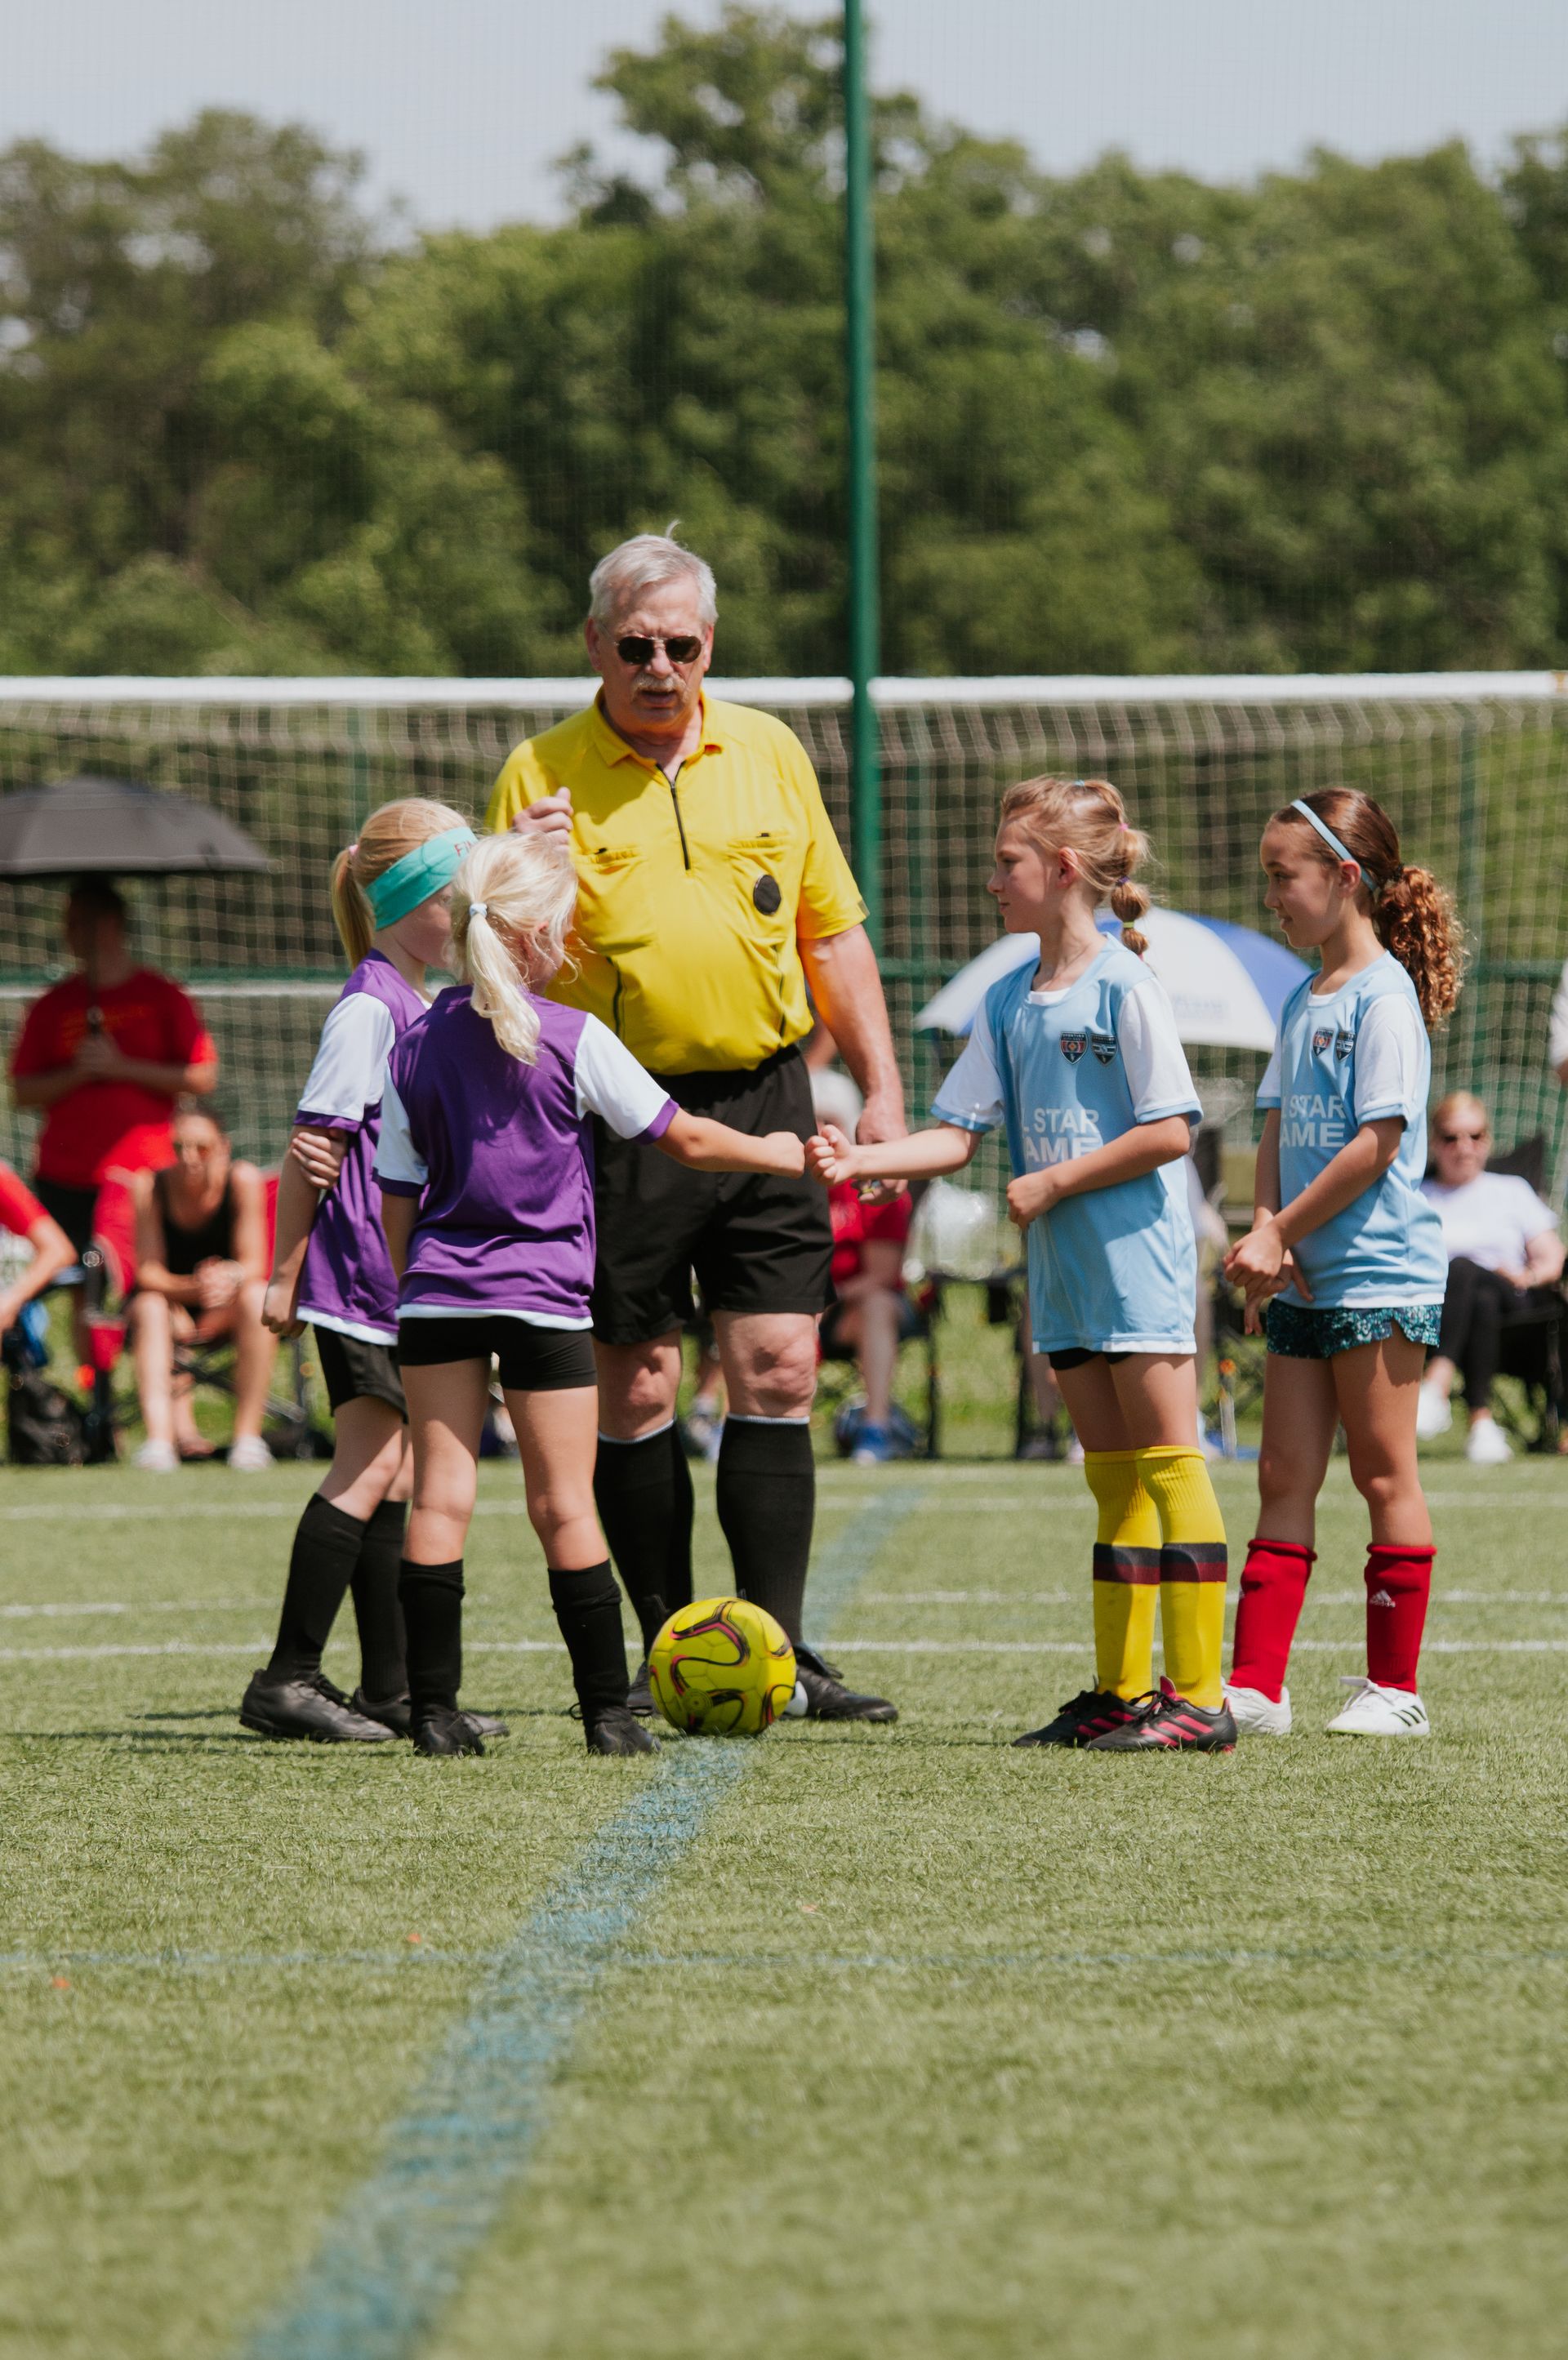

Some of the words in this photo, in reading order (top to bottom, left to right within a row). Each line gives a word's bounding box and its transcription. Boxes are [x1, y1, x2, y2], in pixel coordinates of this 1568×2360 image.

[1290, 1094, 1346, 1119] STAR
[1033, 1107, 1099, 1133] STAR
[1279, 1122, 1346, 1148] AME
[1024, 1137, 1100, 1163] AME
